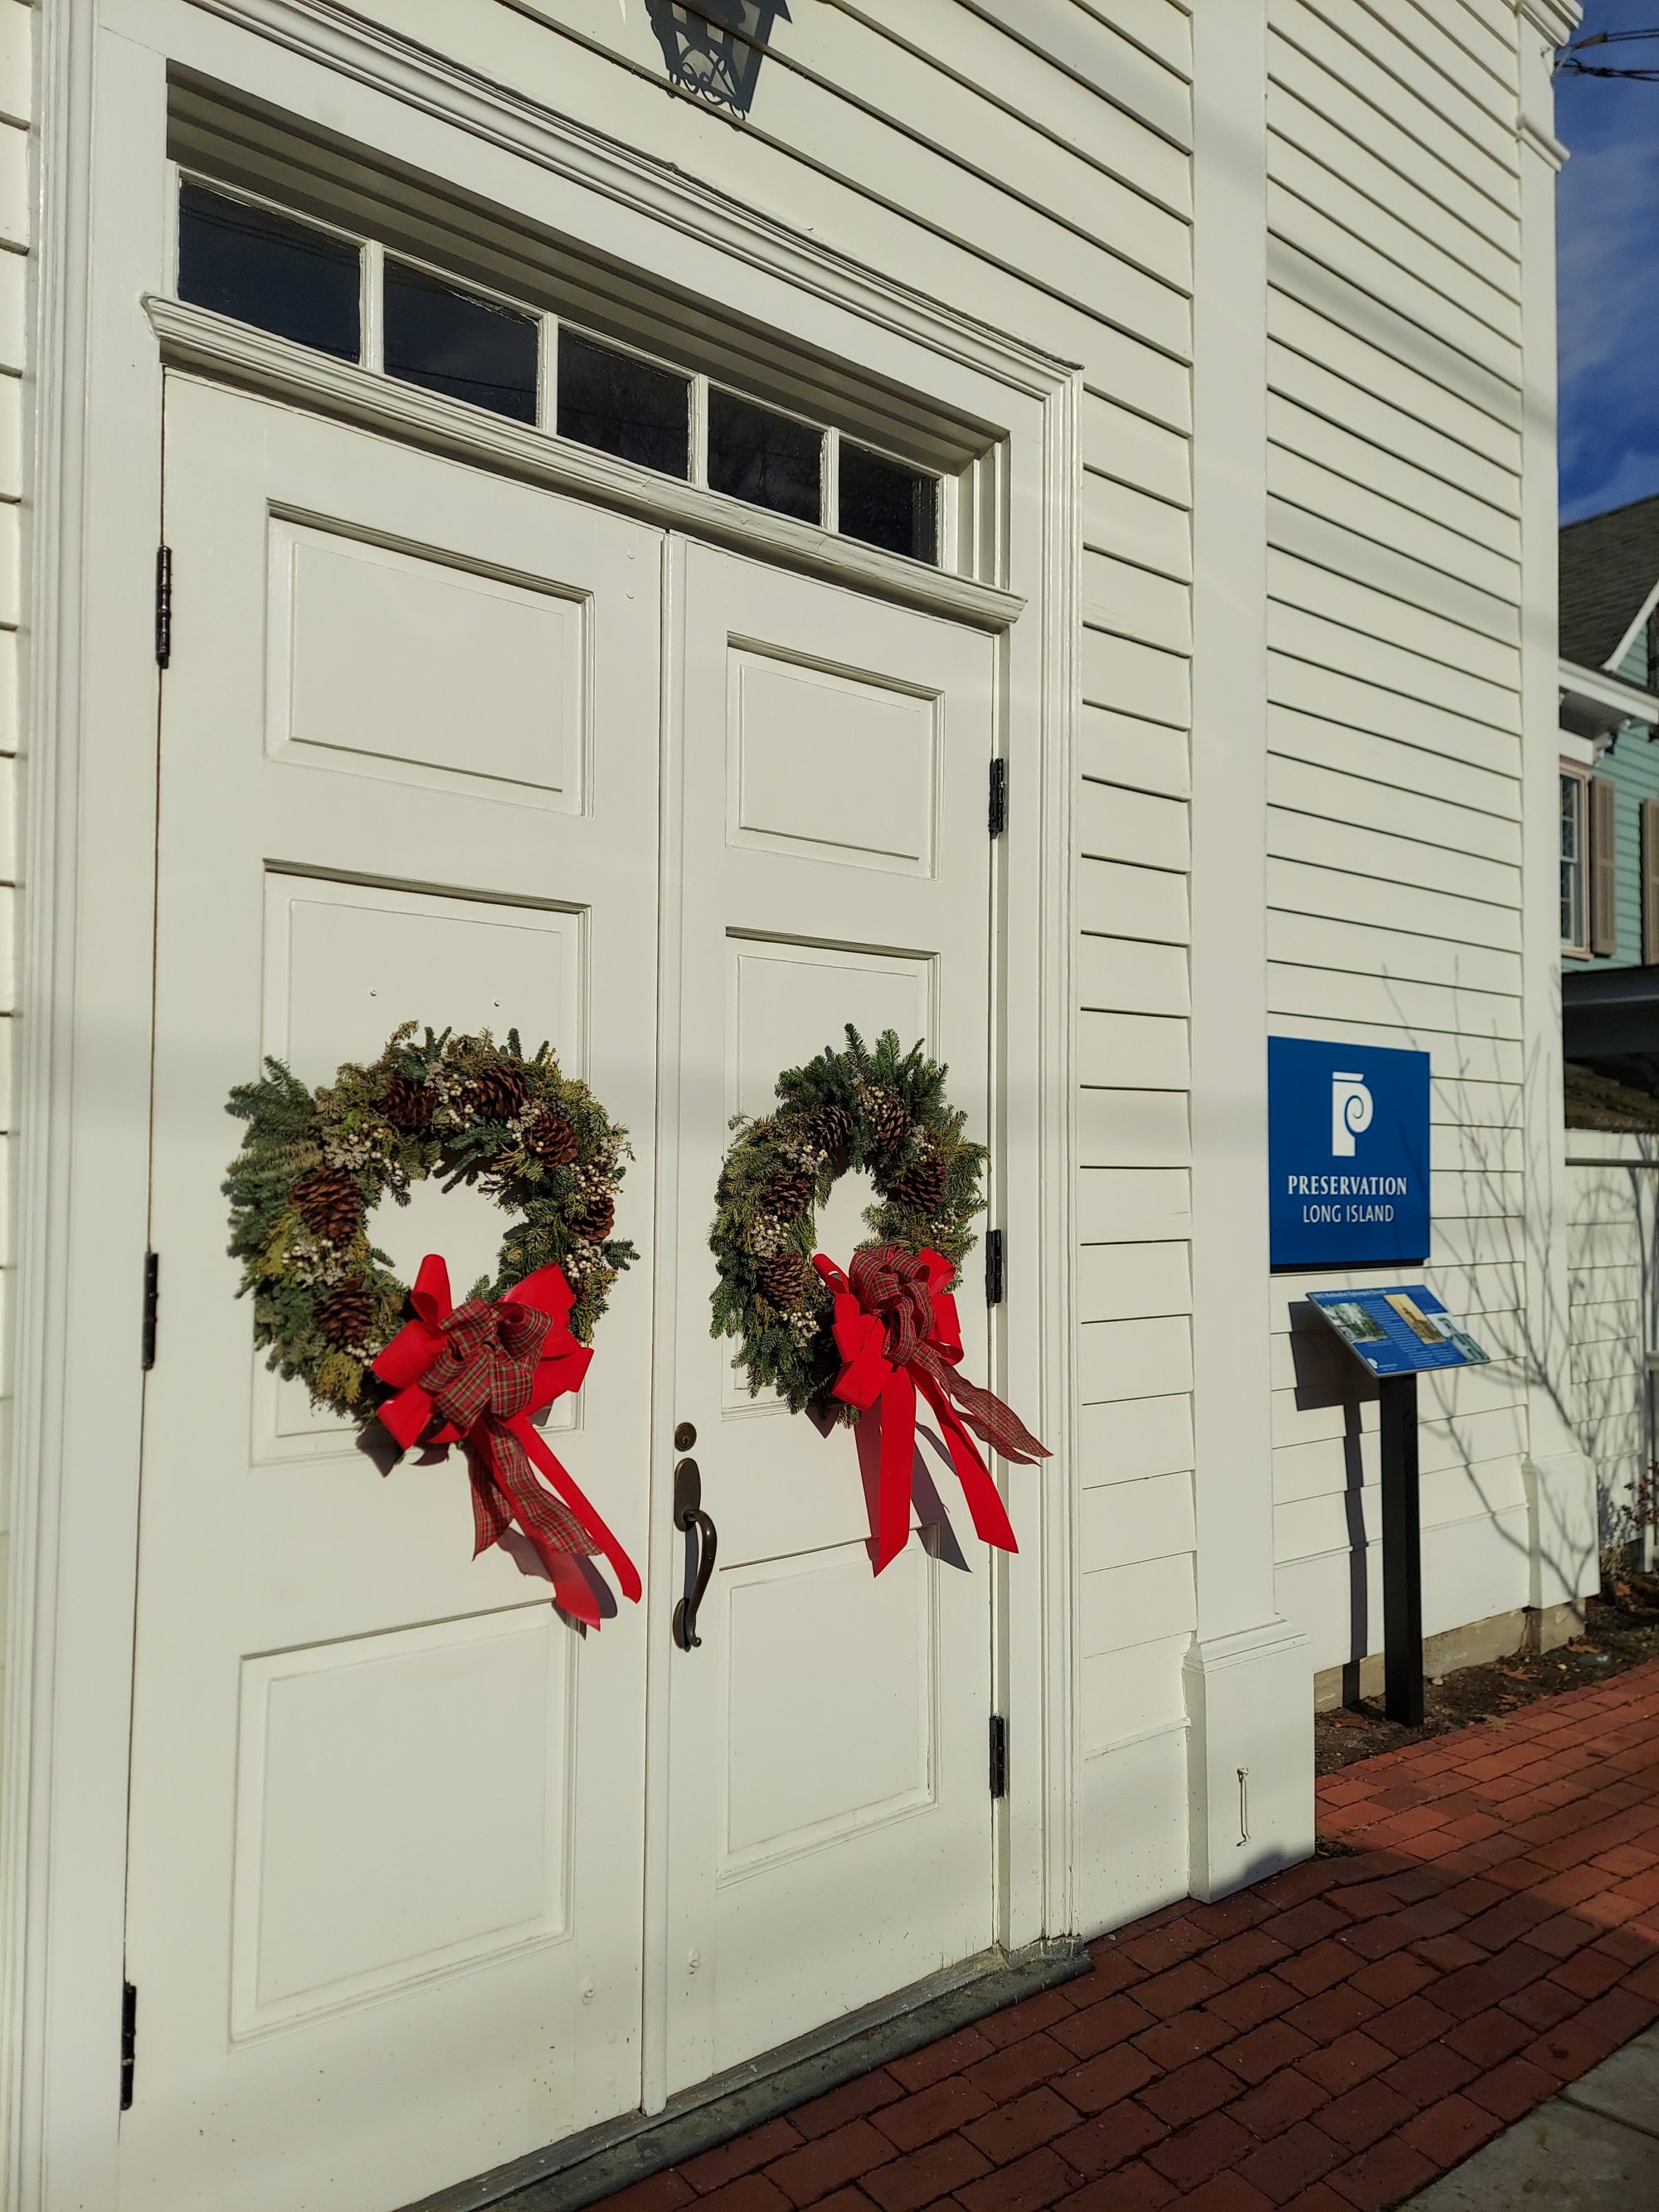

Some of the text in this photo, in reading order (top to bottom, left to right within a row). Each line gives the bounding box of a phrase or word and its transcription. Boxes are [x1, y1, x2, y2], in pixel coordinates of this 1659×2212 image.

[1287, 1174, 1408, 1196] PRESERVATION
[1302, 1204, 1394, 1223] LONG ISLAND
